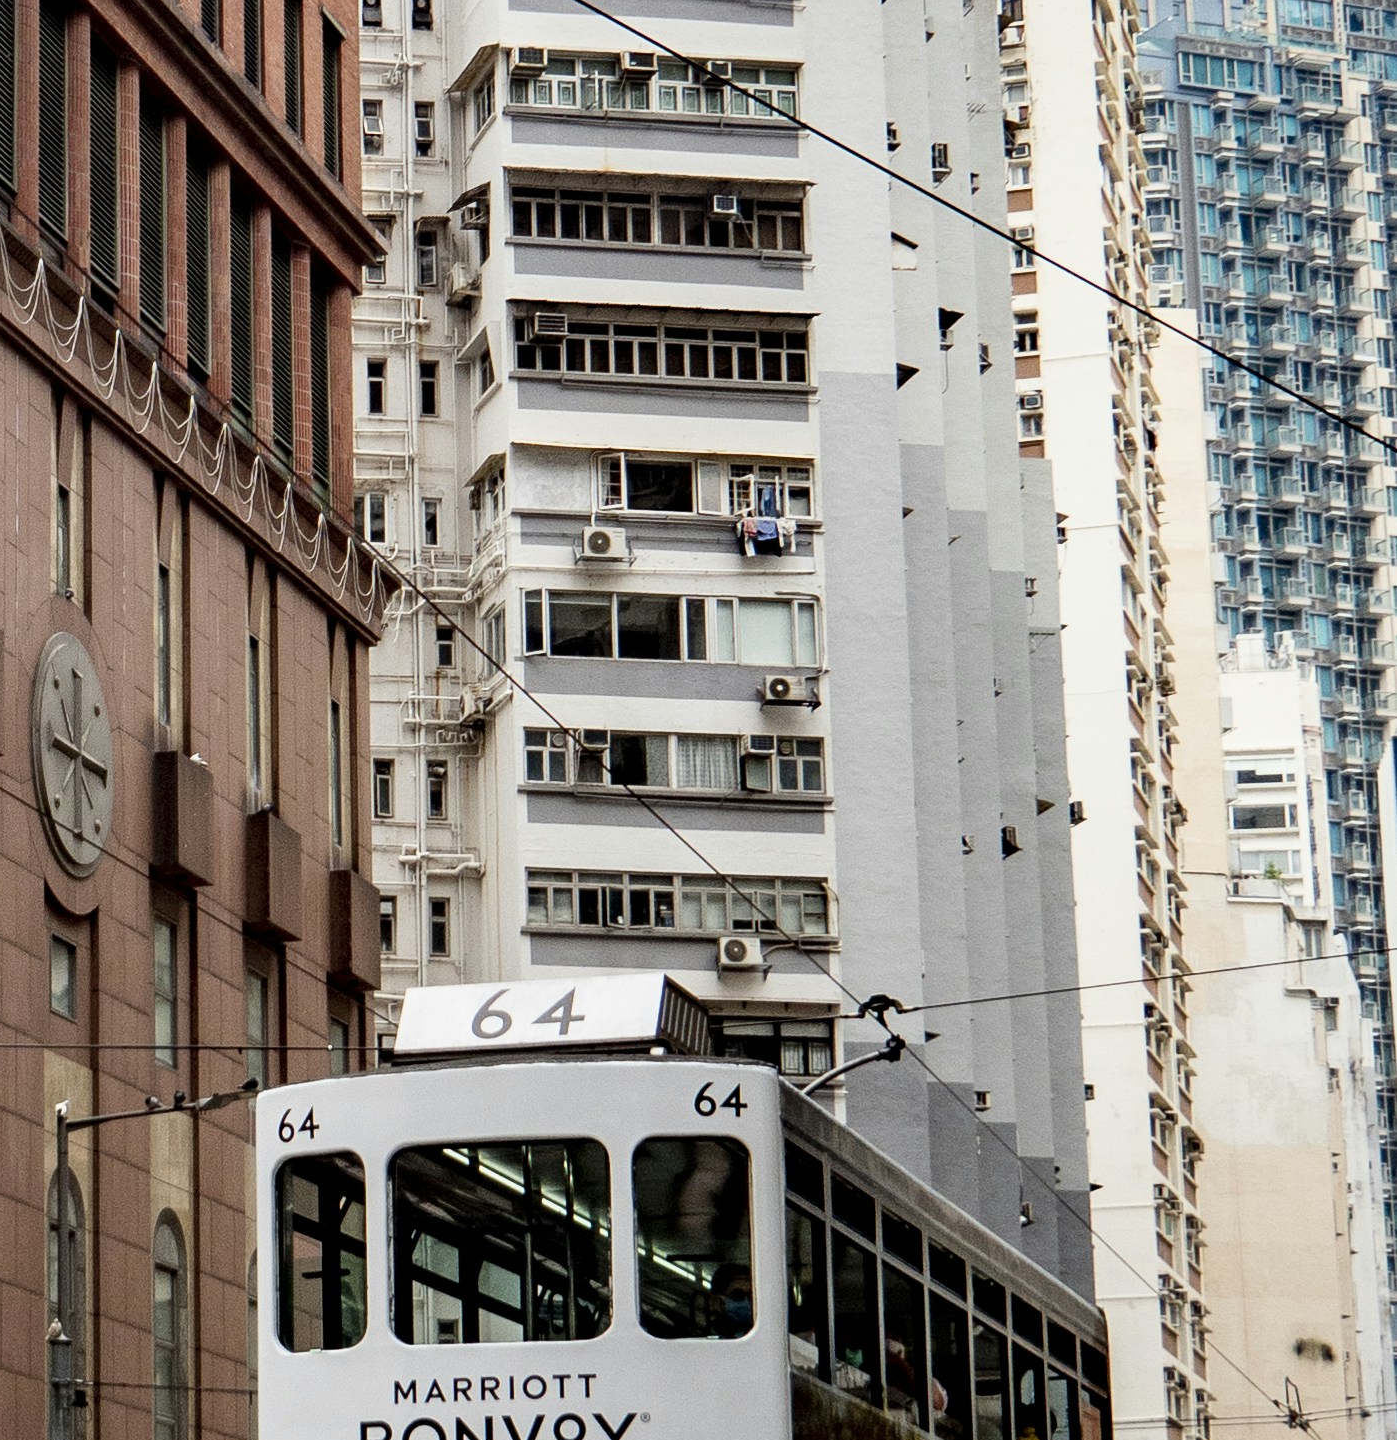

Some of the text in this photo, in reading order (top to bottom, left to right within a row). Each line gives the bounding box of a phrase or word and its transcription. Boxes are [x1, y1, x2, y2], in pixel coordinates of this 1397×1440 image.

[471, 987, 586, 1040] 64
[694, 1081, 748, 1118] 64
[278, 1106, 320, 1143] 64
[393, 1373, 597, 1405] MARRIOTT
